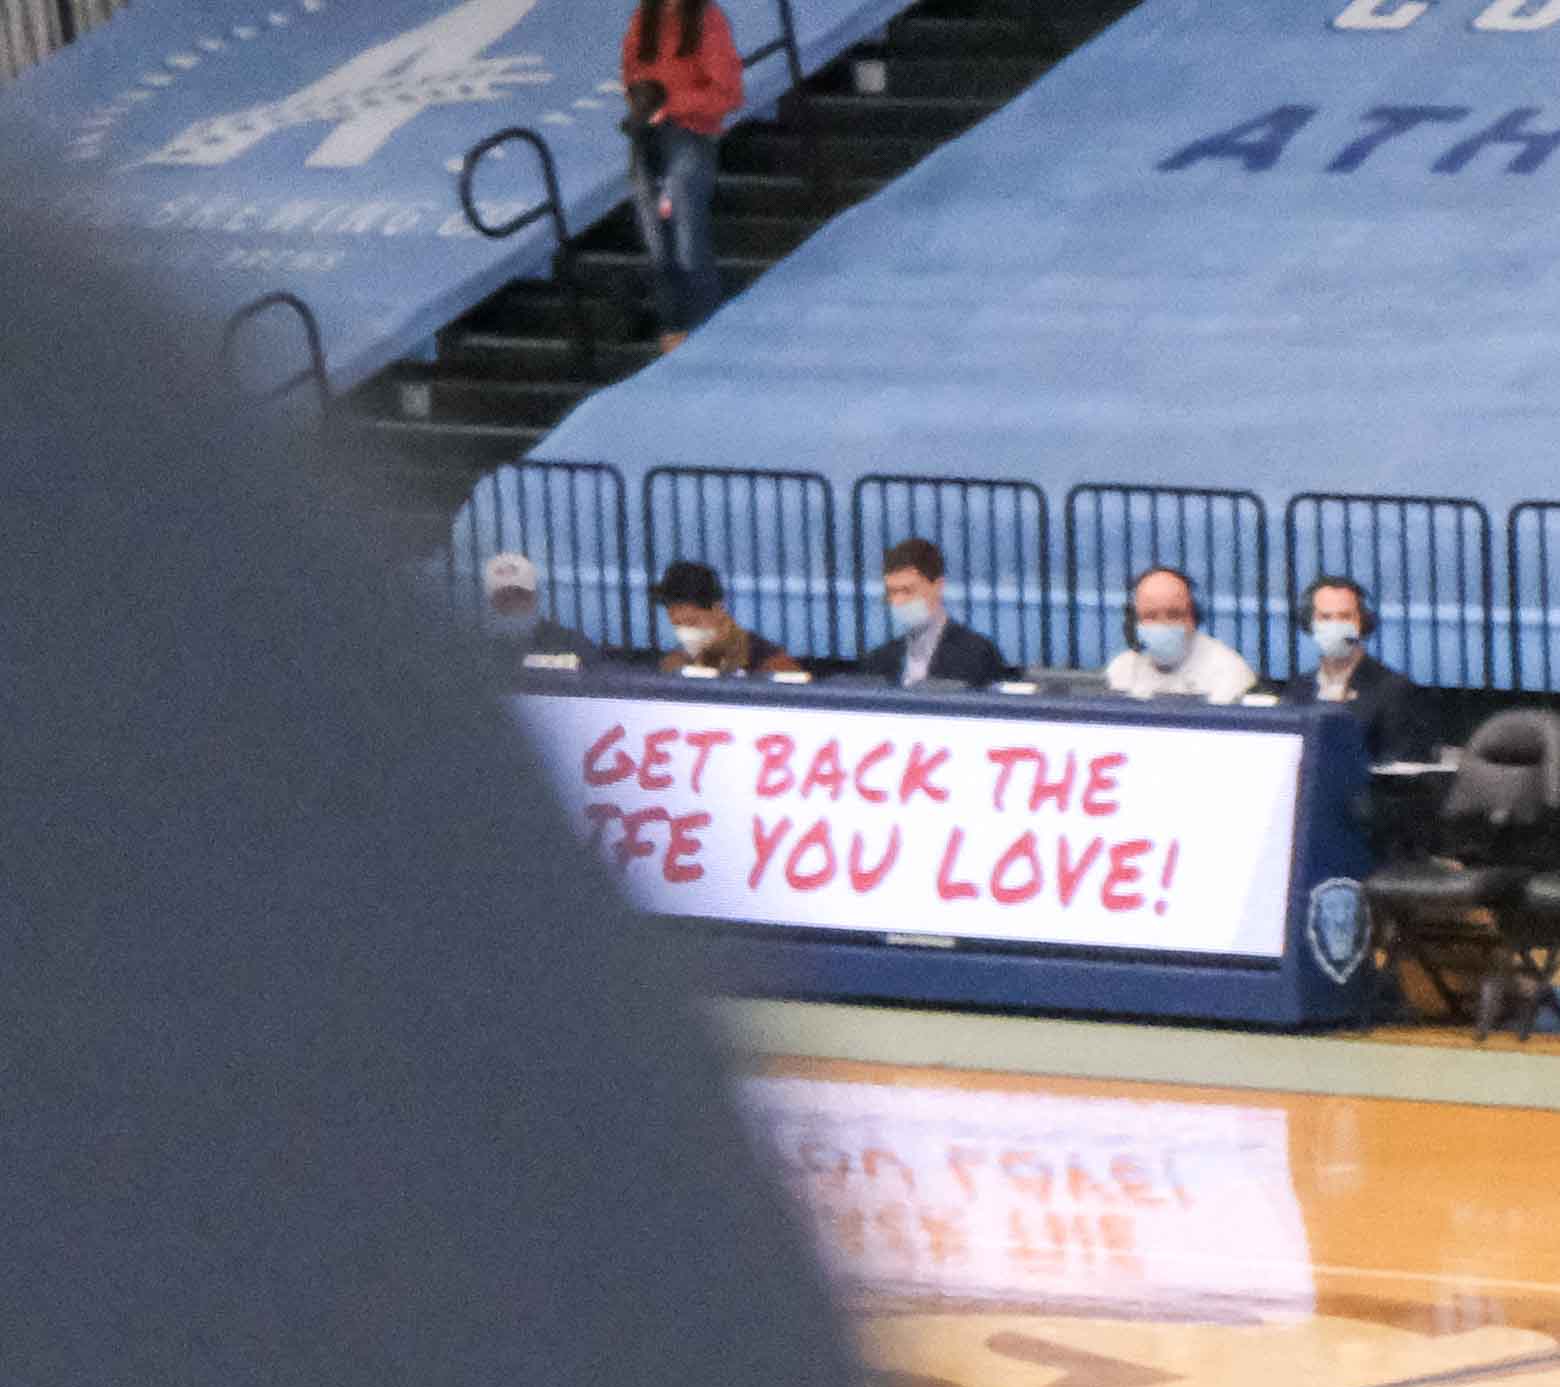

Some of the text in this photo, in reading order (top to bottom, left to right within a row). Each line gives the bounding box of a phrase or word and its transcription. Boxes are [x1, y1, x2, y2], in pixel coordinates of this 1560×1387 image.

[583, 724, 1130, 816] GET BACK THE
[747, 812, 903, 893] YOU
[934, 827, 1181, 916] LOVE!
